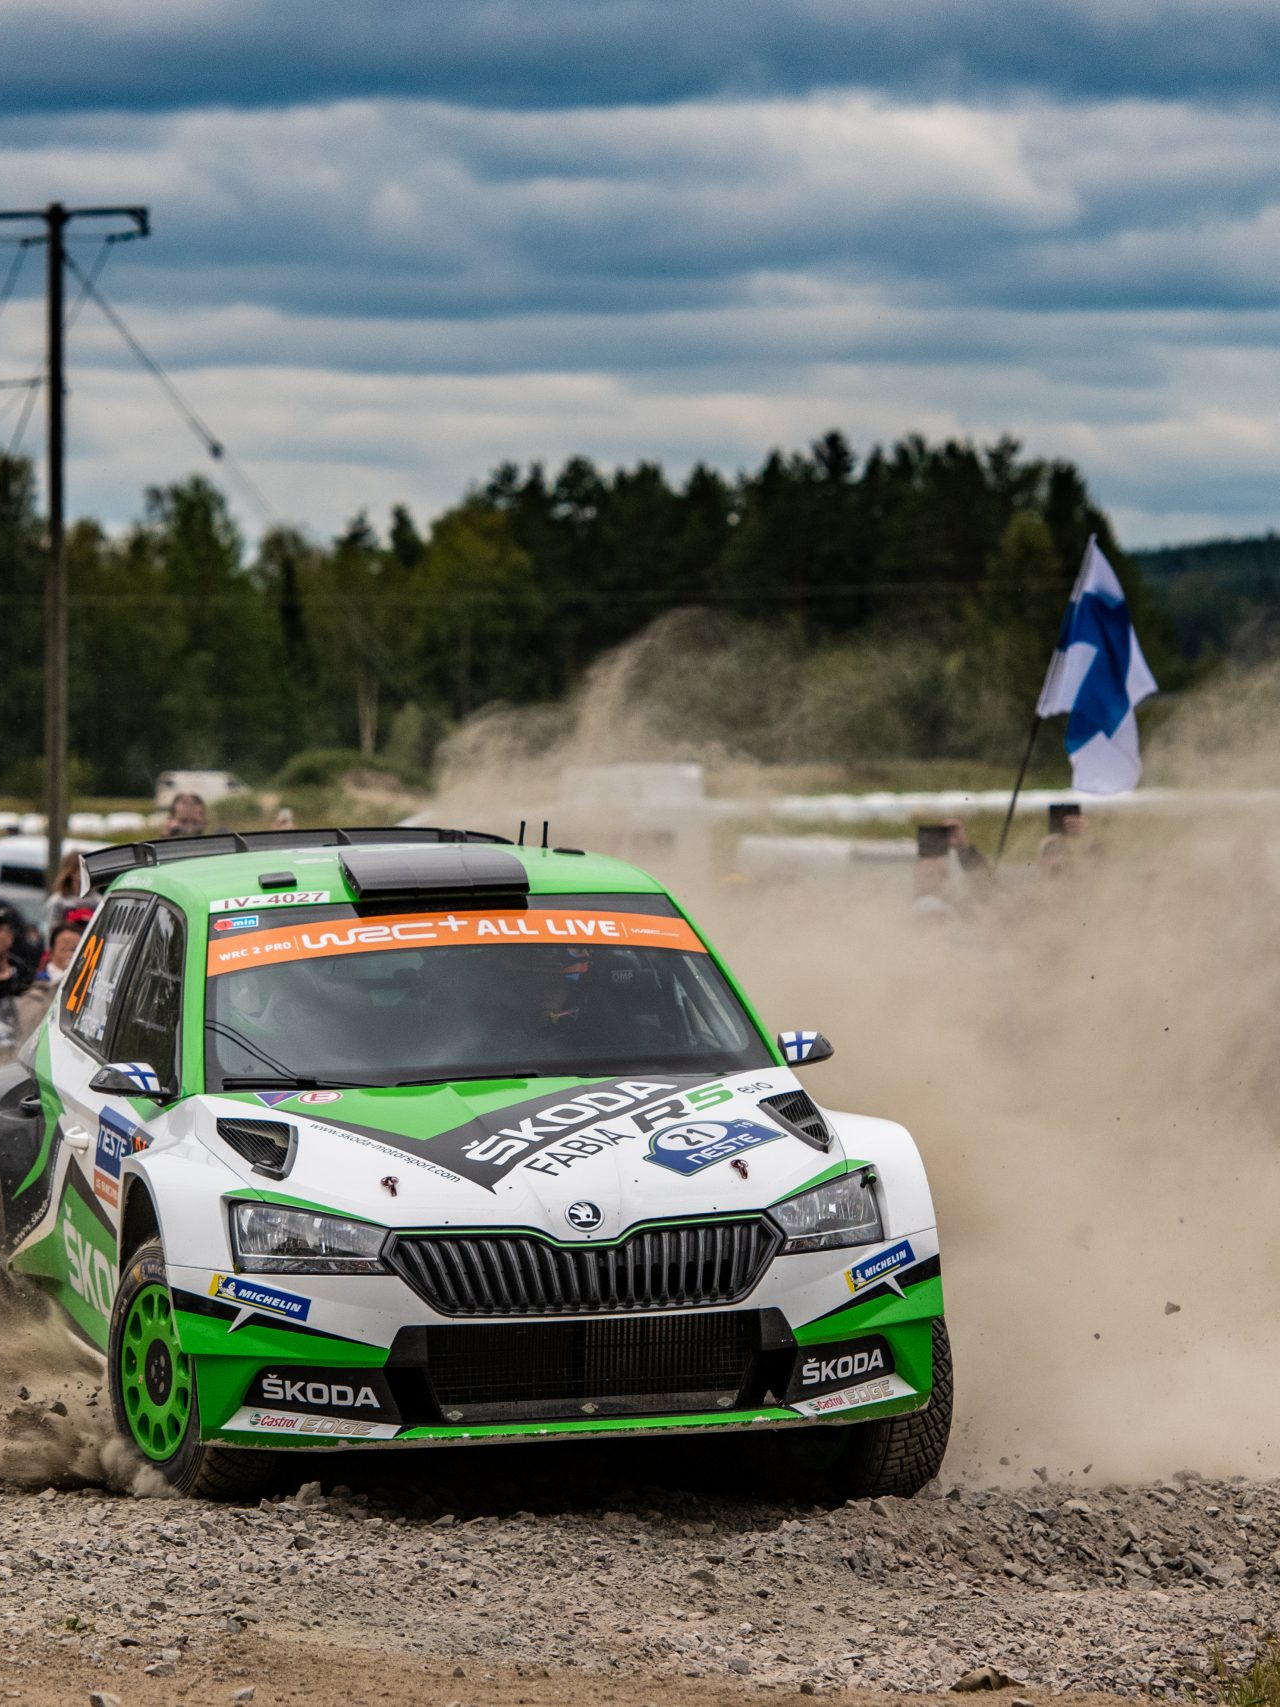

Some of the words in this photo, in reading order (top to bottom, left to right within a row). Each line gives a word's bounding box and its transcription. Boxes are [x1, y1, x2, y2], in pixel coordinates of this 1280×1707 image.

[219, 949, 249, 961] WRC
[253, 947, 261, 955] 2
[264, 941, 292, 953] PRO
[477, 919, 539, 936] ALL
[545, 919, 620, 937] LIVE
[461, 1081, 679, 1166] ŠKODA
[523, 1128, 637, 1177] FABIA
[737, 1081, 774, 1095] evo
[667, 1128, 717, 1147] 21
[864, 1249, 907, 1278] MICHELIN
[238, 1288, 302, 1313] MICHELIN
[802, 1348, 884, 1385] ŠKODA
[262, 1374, 381, 1409] ŠKODA
[817, 1394, 844, 1410] Castrol
[844, 1379, 895, 1404] EDGE
[260, 1415, 299, 1429] Castrol
[299, 1417, 379, 1436] EDGE
